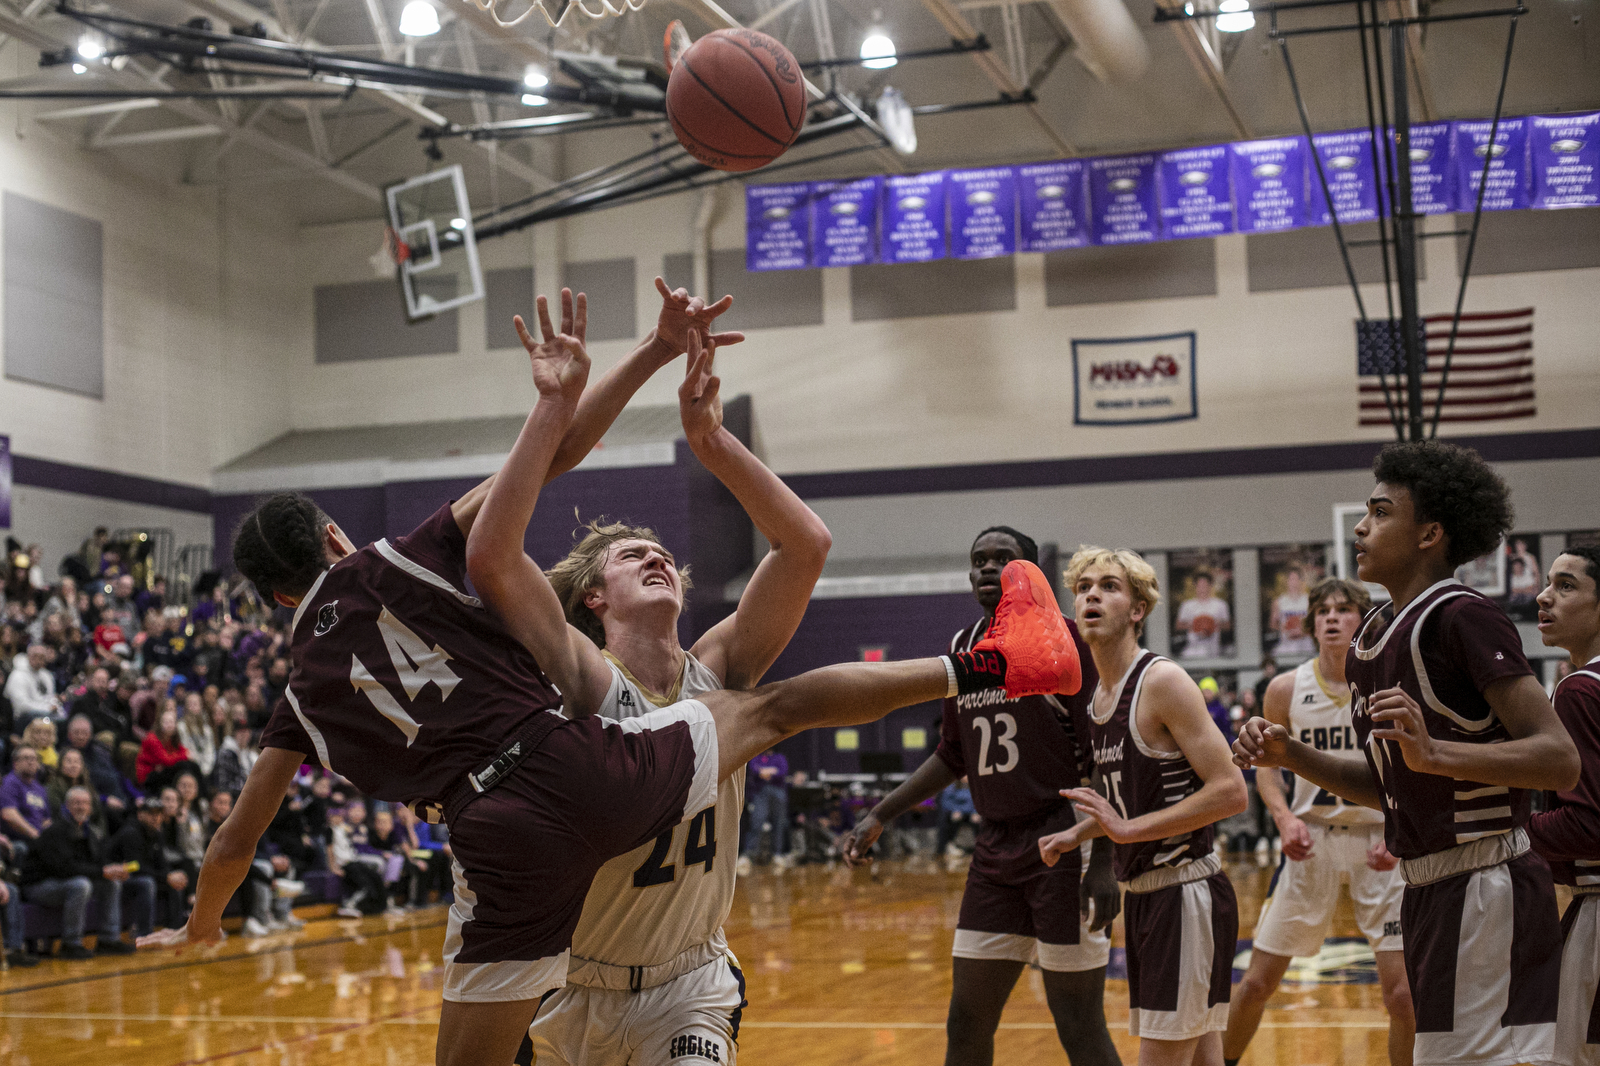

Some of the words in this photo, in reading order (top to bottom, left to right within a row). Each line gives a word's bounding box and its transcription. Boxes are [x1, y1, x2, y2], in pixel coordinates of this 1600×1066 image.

[350, 604, 463, 748] 14
[972, 712, 1020, 776] 23
[632, 804, 717, 888] 24
[669, 1034, 720, 1063] EAGLES
